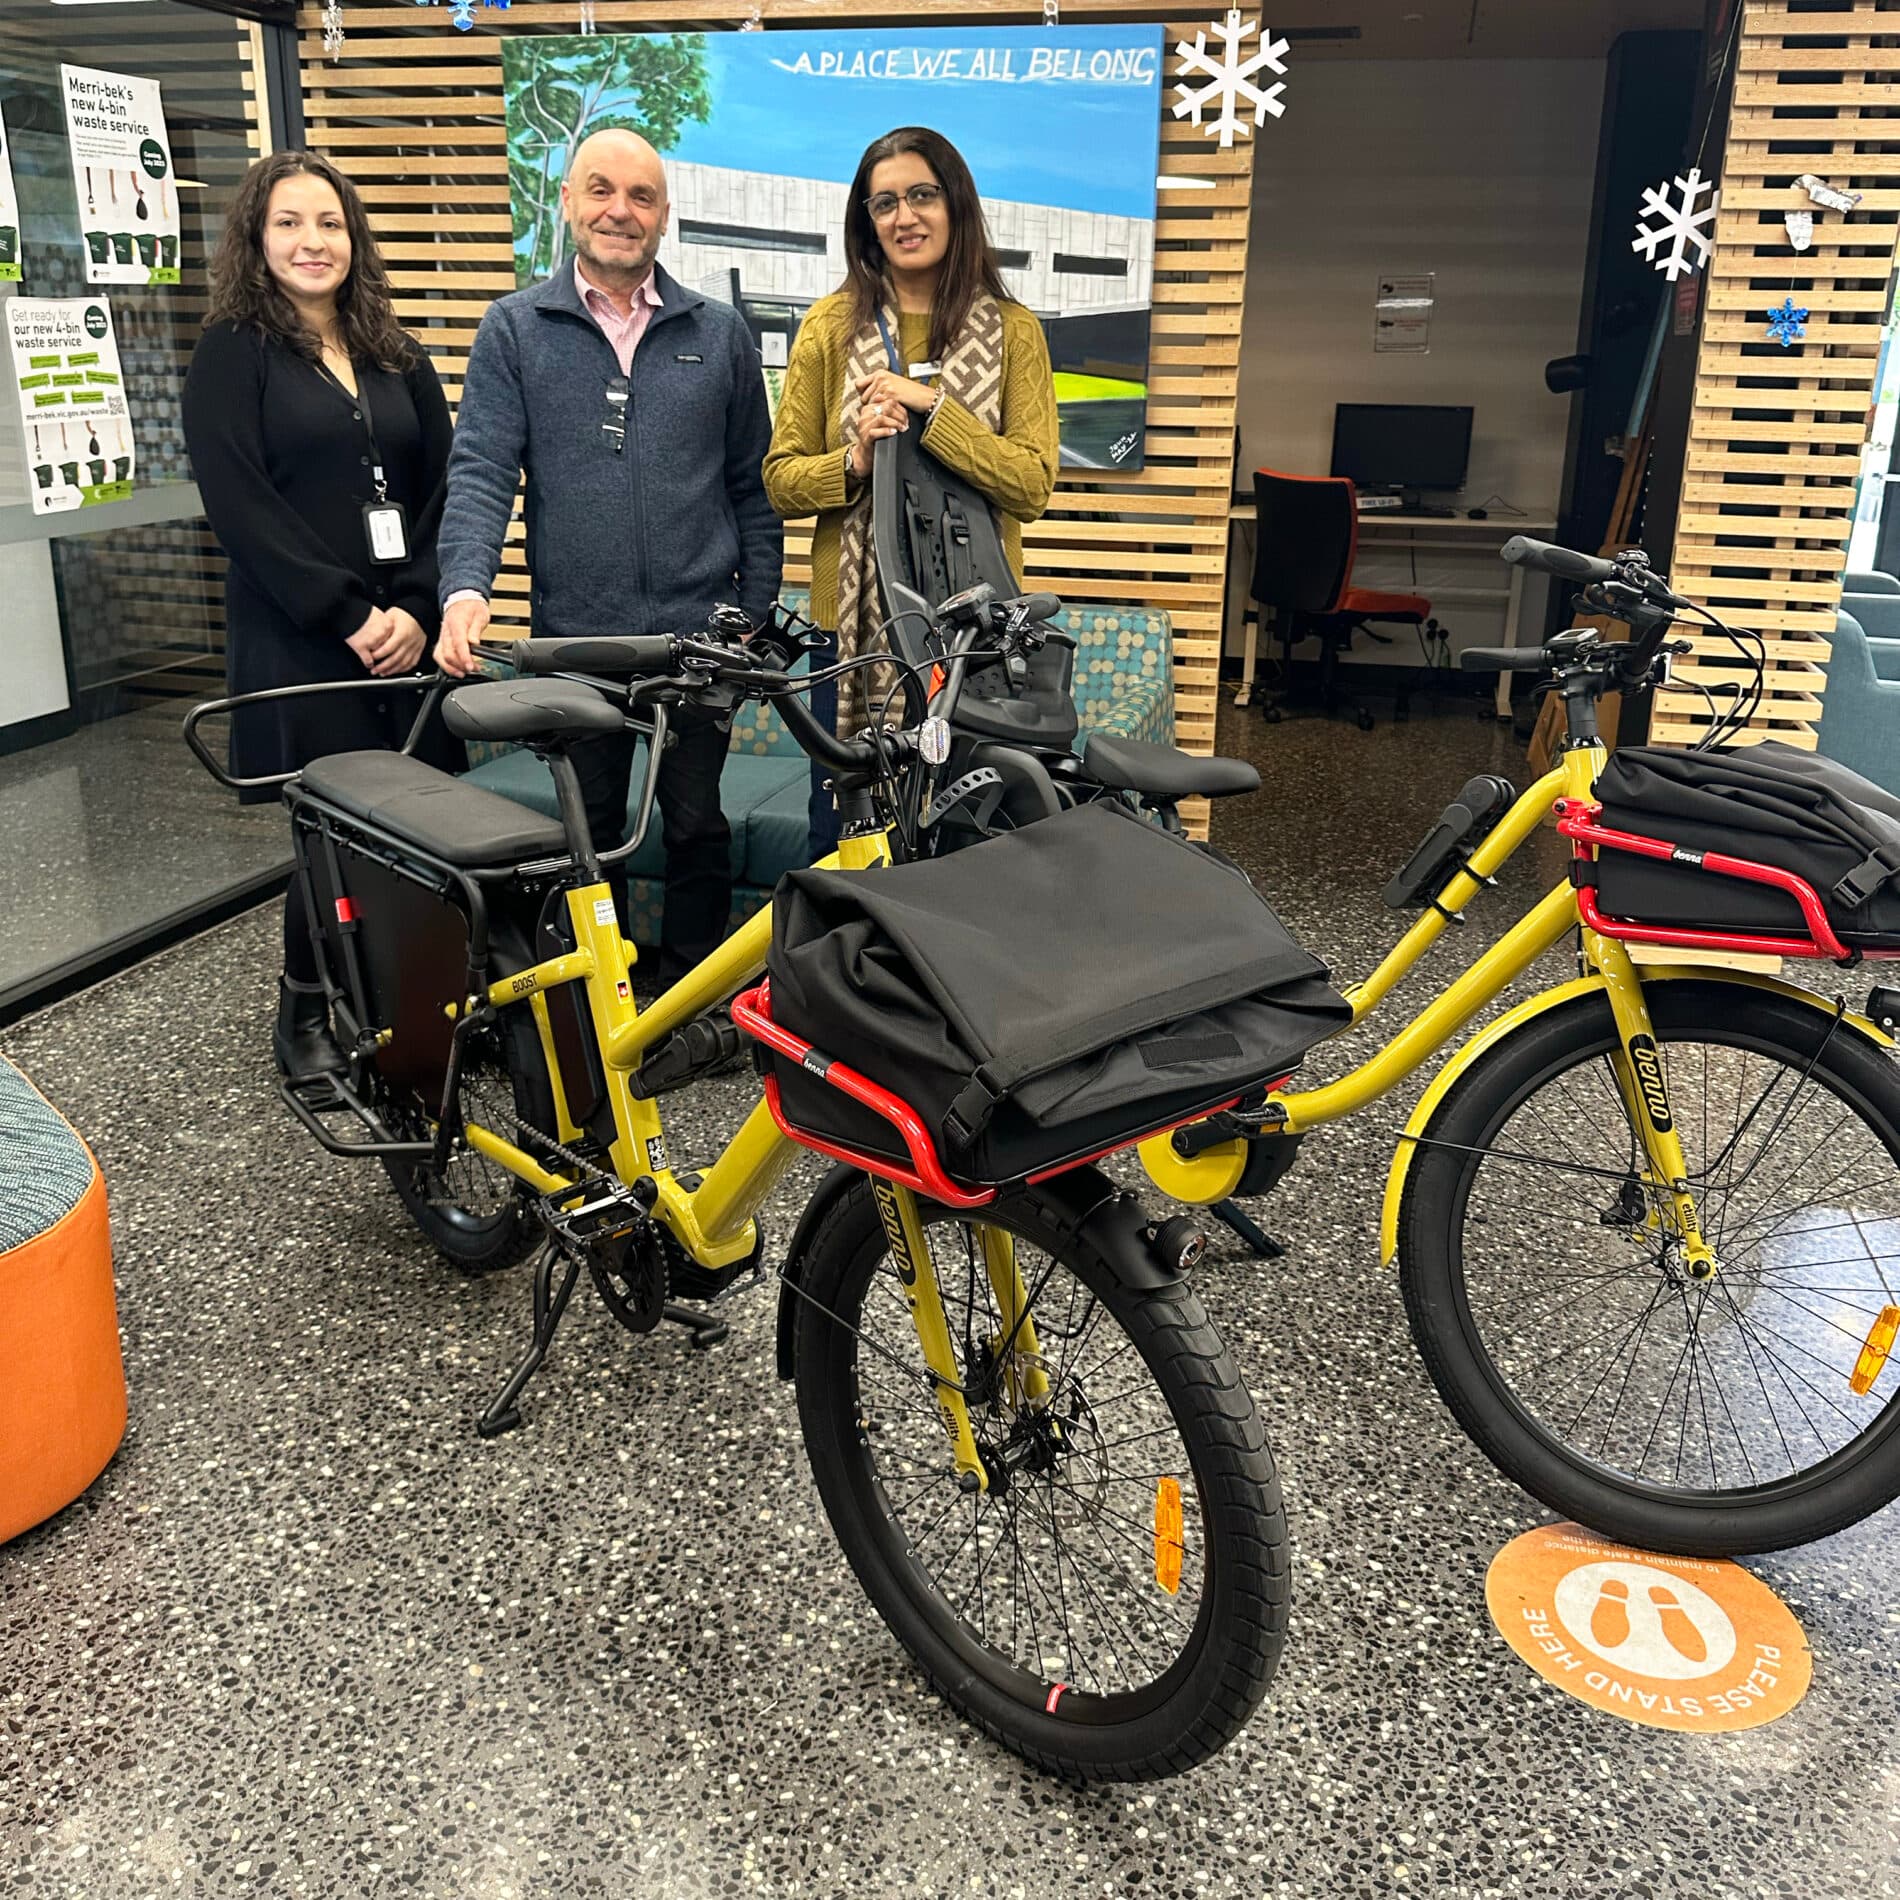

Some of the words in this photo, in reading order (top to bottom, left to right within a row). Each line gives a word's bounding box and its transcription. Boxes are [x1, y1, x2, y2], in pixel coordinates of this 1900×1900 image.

[819, 49, 901, 78] PLACE
[911, 49, 962, 79] WE
[967, 48, 1016, 79] ALL
[1026, 47, 1156, 84] BELONG
[69, 76, 134, 101] Merri-bek's
[71, 97, 98, 112] new
[98, 99, 127, 117] 4-bin
[73, 114, 108, 131] waste
[110, 120, 150, 136] service
[11, 308, 29, 322] Get
[30, 309, 57, 324] ready
[58, 308, 72, 321] for
[14, 325, 31, 336] our
[33, 323, 54, 334] new
[56, 322, 81, 334] 4-bin
[16, 337, 46, 349] waste
[47, 336, 82, 348] service
[512, 973, 538, 993] BOOST
[1634, 1047, 1670, 1121] benno
[874, 1184, 911, 1271] benno
[1682, 1203, 1697, 1233] etility
[942, 1405, 960, 1443] etility
[1543, 1540, 1600, 1555] distance
[1602, 1549, 1631, 1560] safe
[1645, 1556, 1702, 1570] maintain
[1522, 1606, 1583, 1673] HERE
[1706, 1642, 1782, 1715] PLEASE
[1583, 1670, 1703, 1717] STAND
